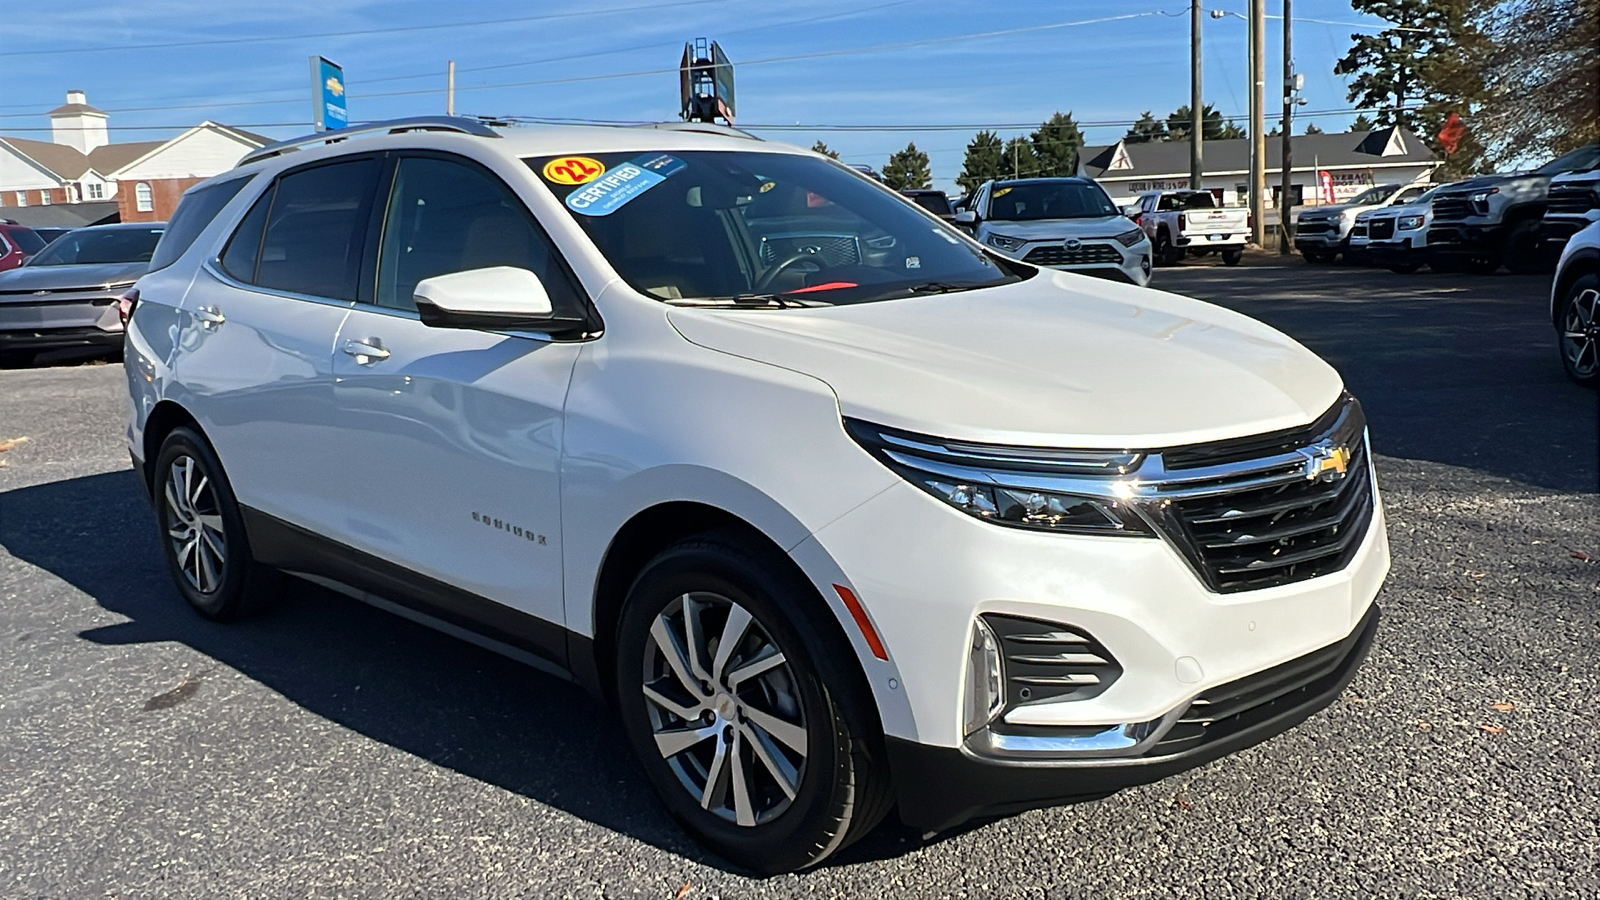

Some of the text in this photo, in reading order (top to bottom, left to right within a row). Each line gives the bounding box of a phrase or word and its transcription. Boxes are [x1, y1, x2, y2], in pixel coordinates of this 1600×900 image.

[555, 160, 598, 182] 22
[570, 166, 641, 208] CERTIFIED
[471, 511, 547, 546] EQUINOX
